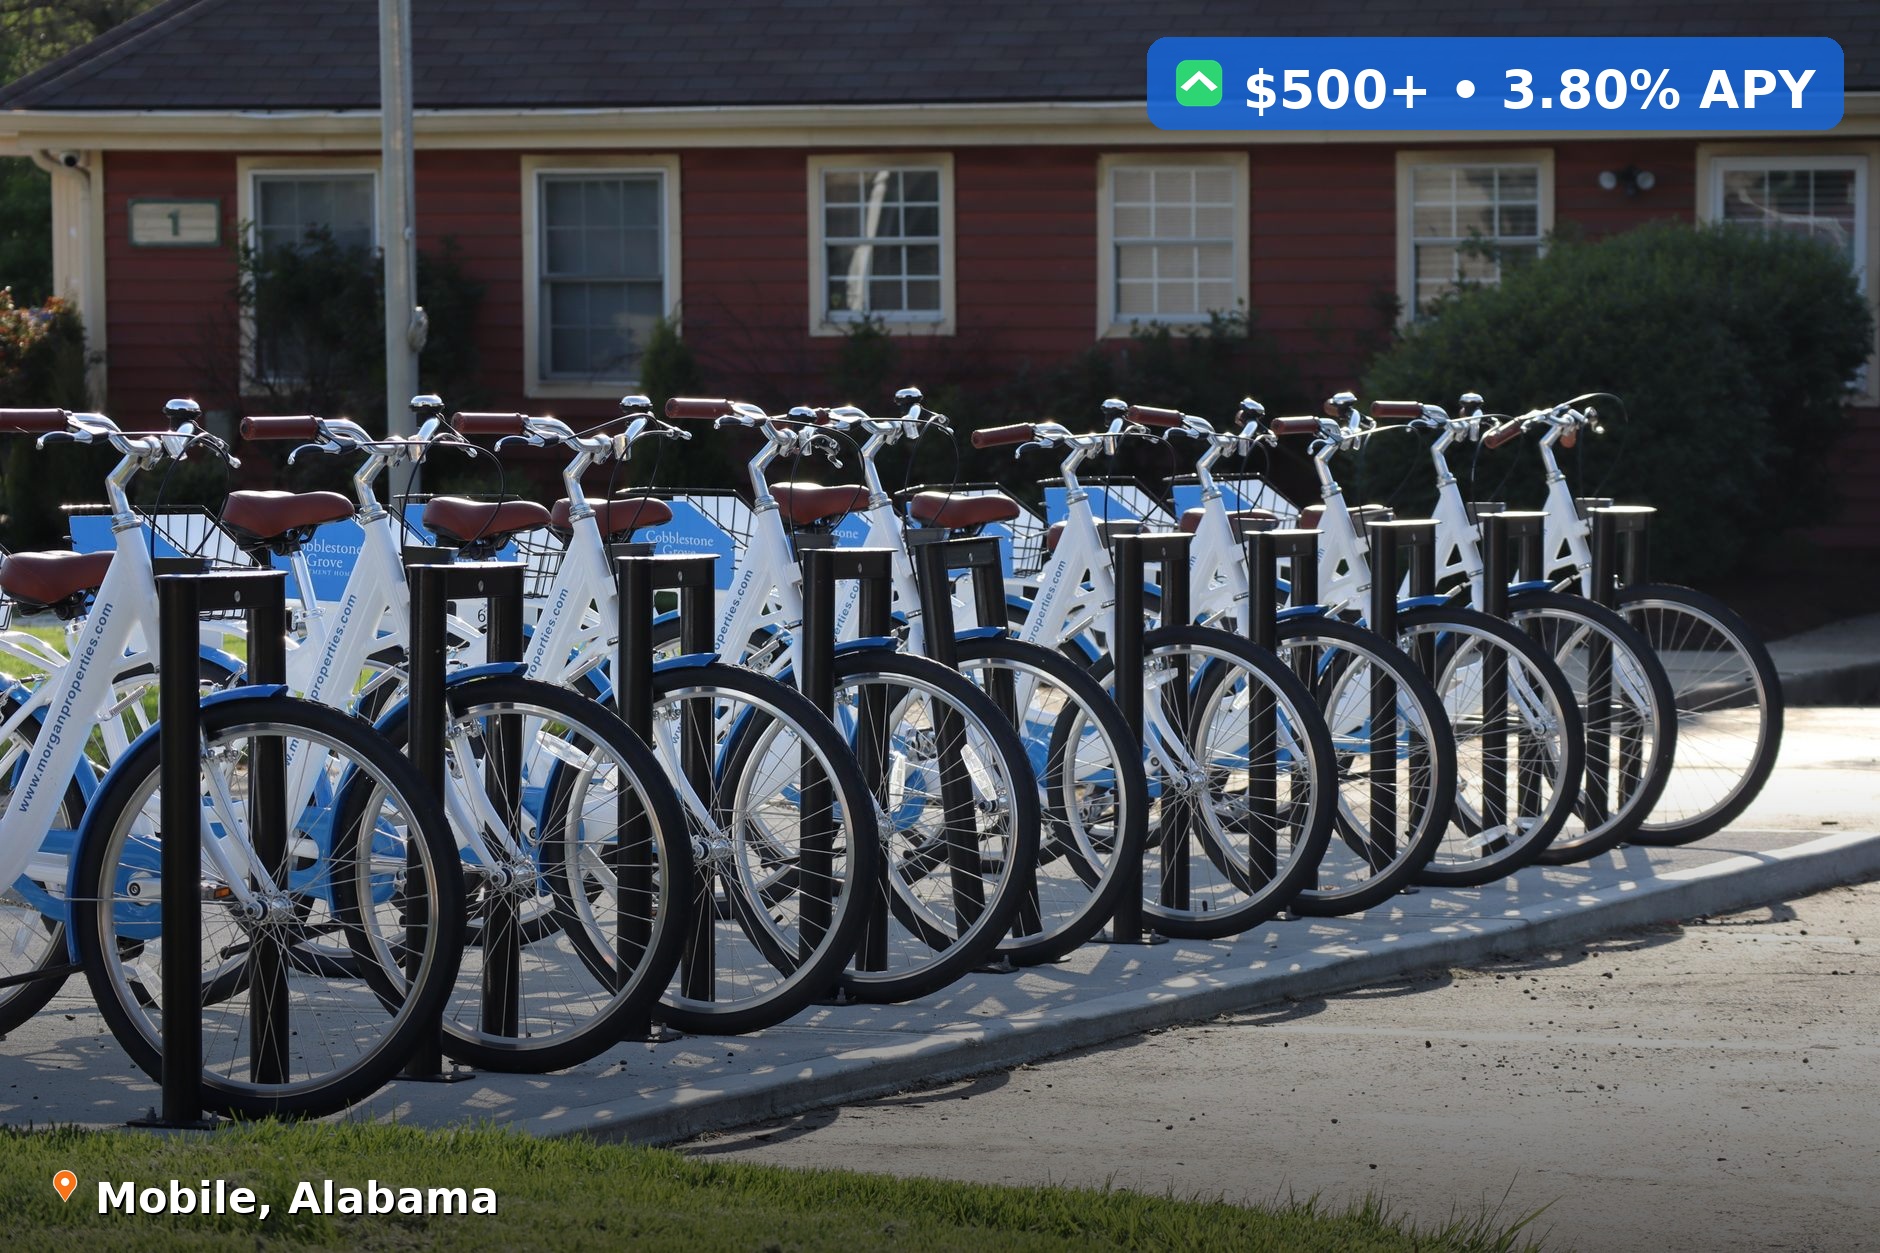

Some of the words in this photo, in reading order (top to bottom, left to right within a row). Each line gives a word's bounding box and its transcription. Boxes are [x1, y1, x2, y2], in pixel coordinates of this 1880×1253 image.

[167, 208, 180, 237] 1
[301, 538, 361, 555] obblestone
[645, 530, 715, 547] Cobblestone
[306, 553, 343, 569] Grove
[714, 569, 753, 650] operties.com
[527, 588, 569, 679] roperties.com
[18, 602, 114, 813] www.morganproperties.com
